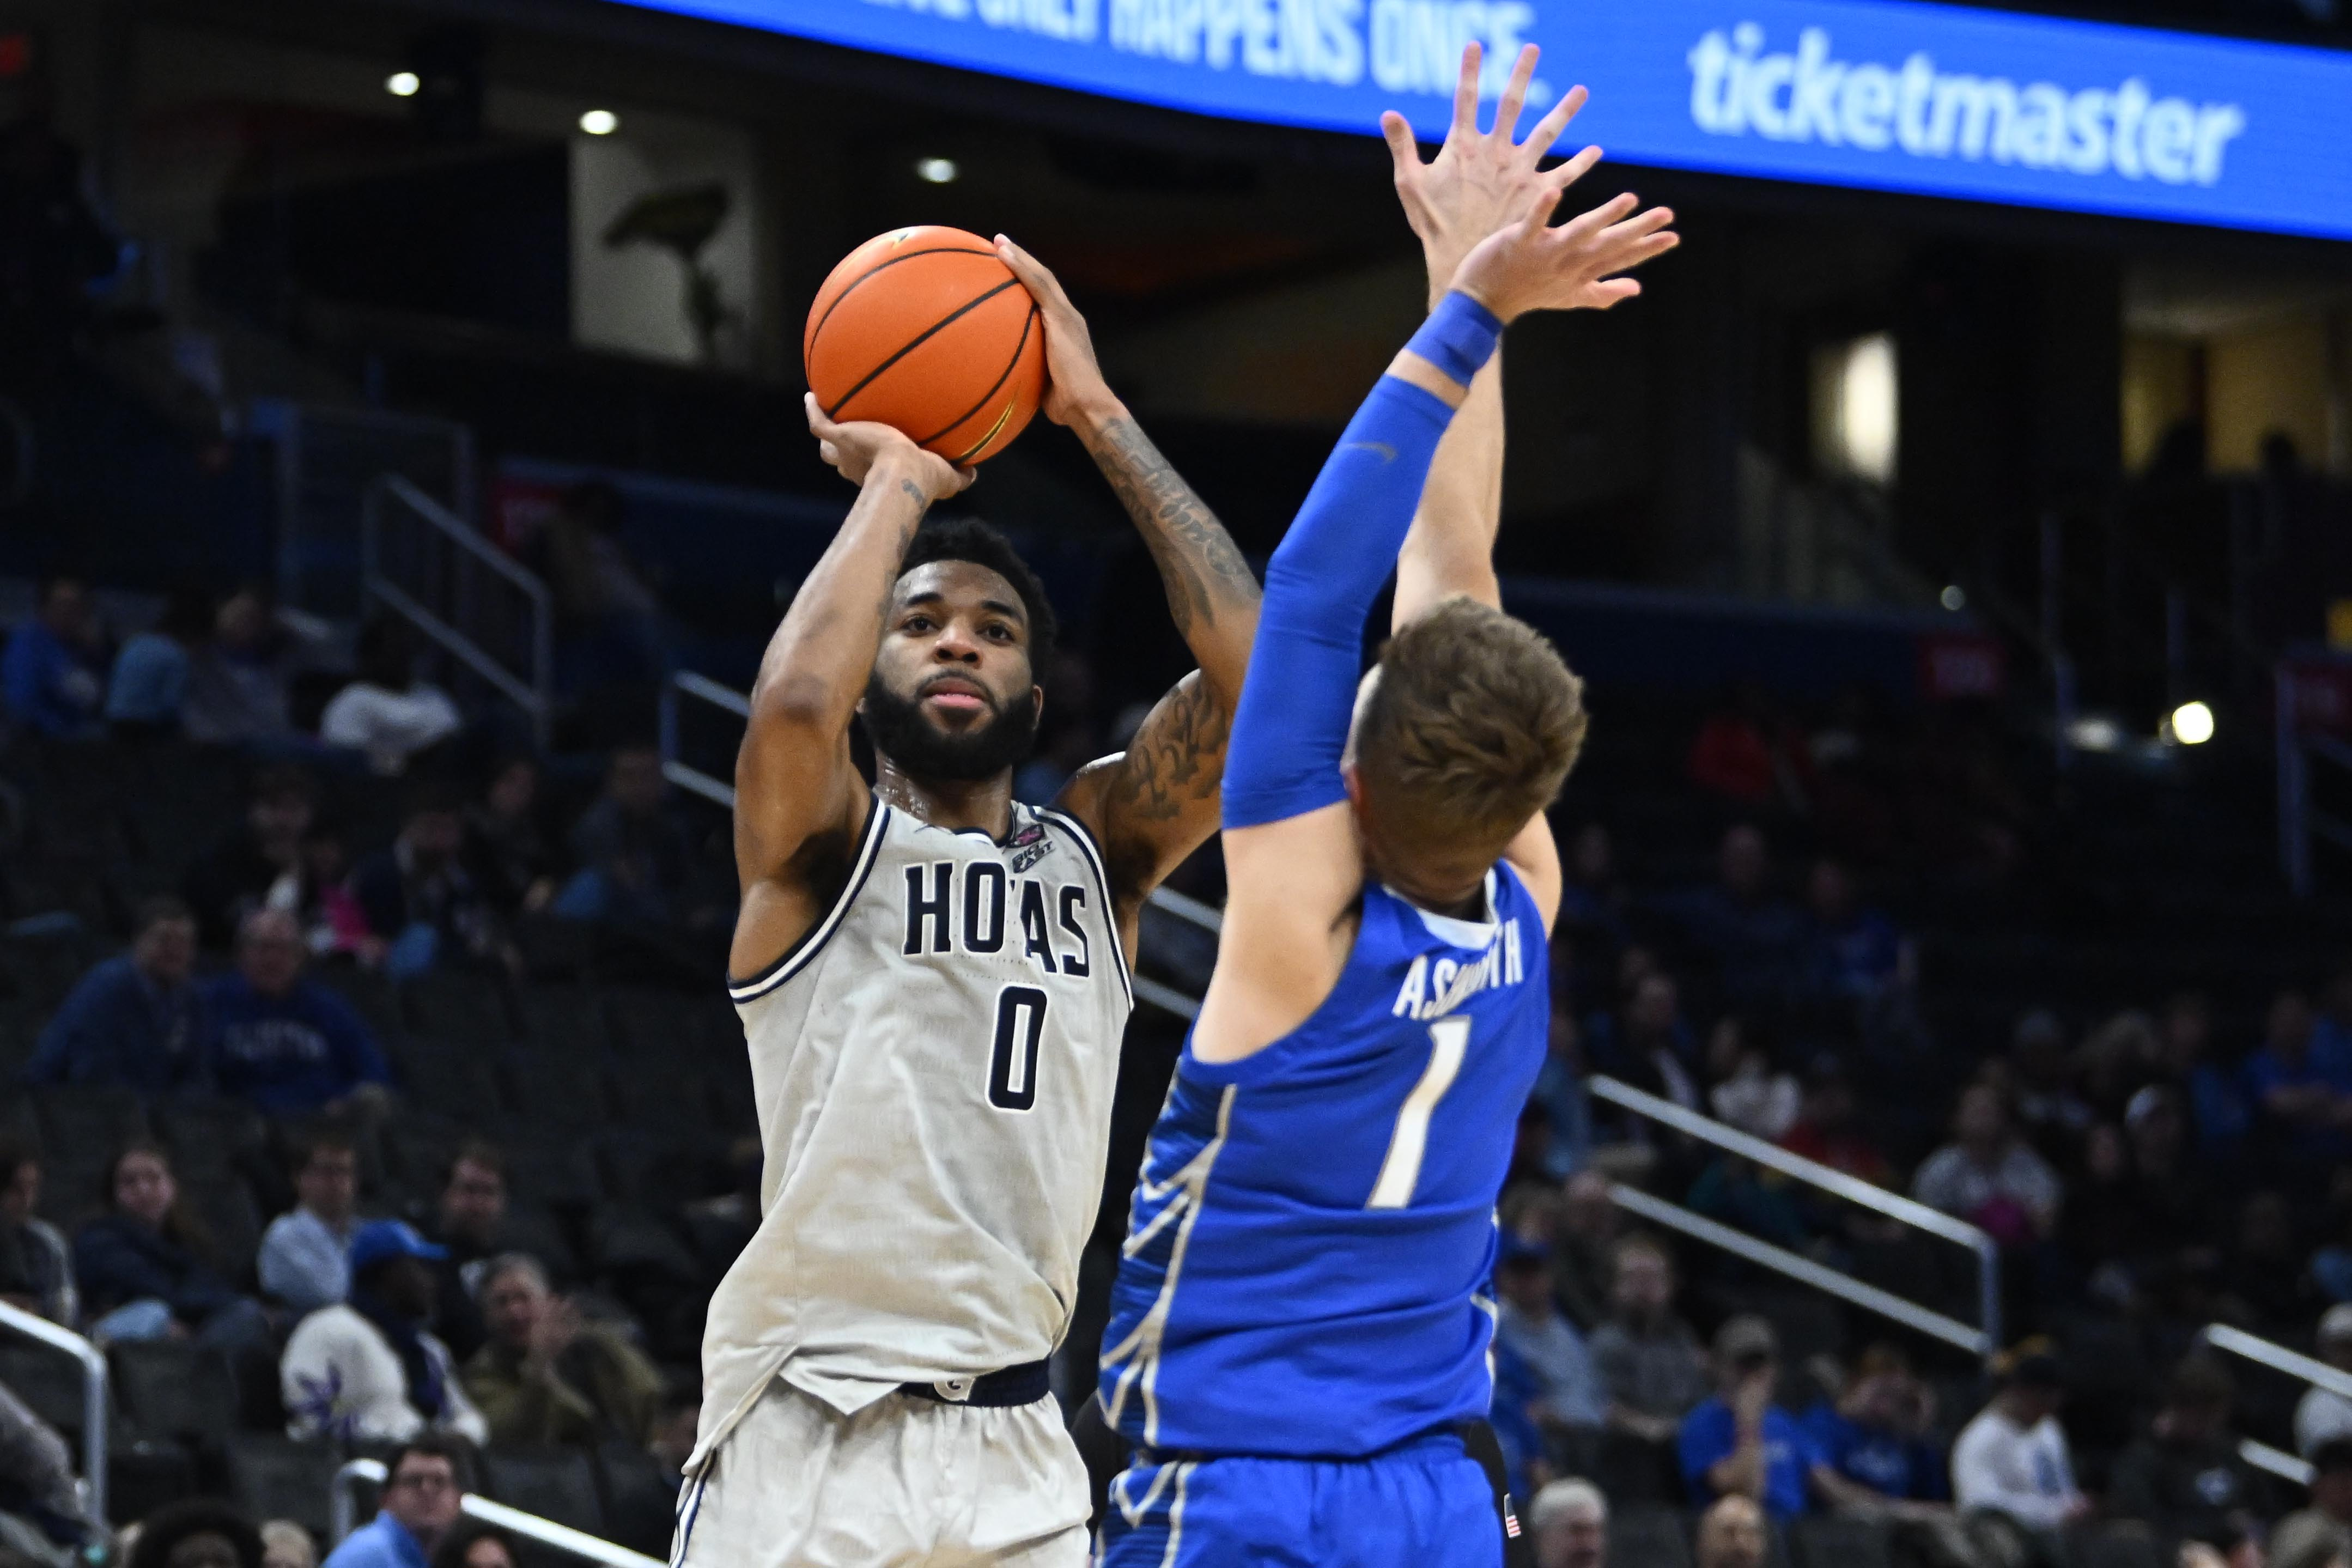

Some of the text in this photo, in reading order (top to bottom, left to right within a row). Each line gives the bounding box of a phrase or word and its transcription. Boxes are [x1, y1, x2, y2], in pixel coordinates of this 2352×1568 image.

[1688, 22, 2244, 186] ticketmaster
[901, 859, 1090, 978] HOAS
[984, 982, 1048, 1115] 0
[1363, 1014, 1471, 1211] 1
